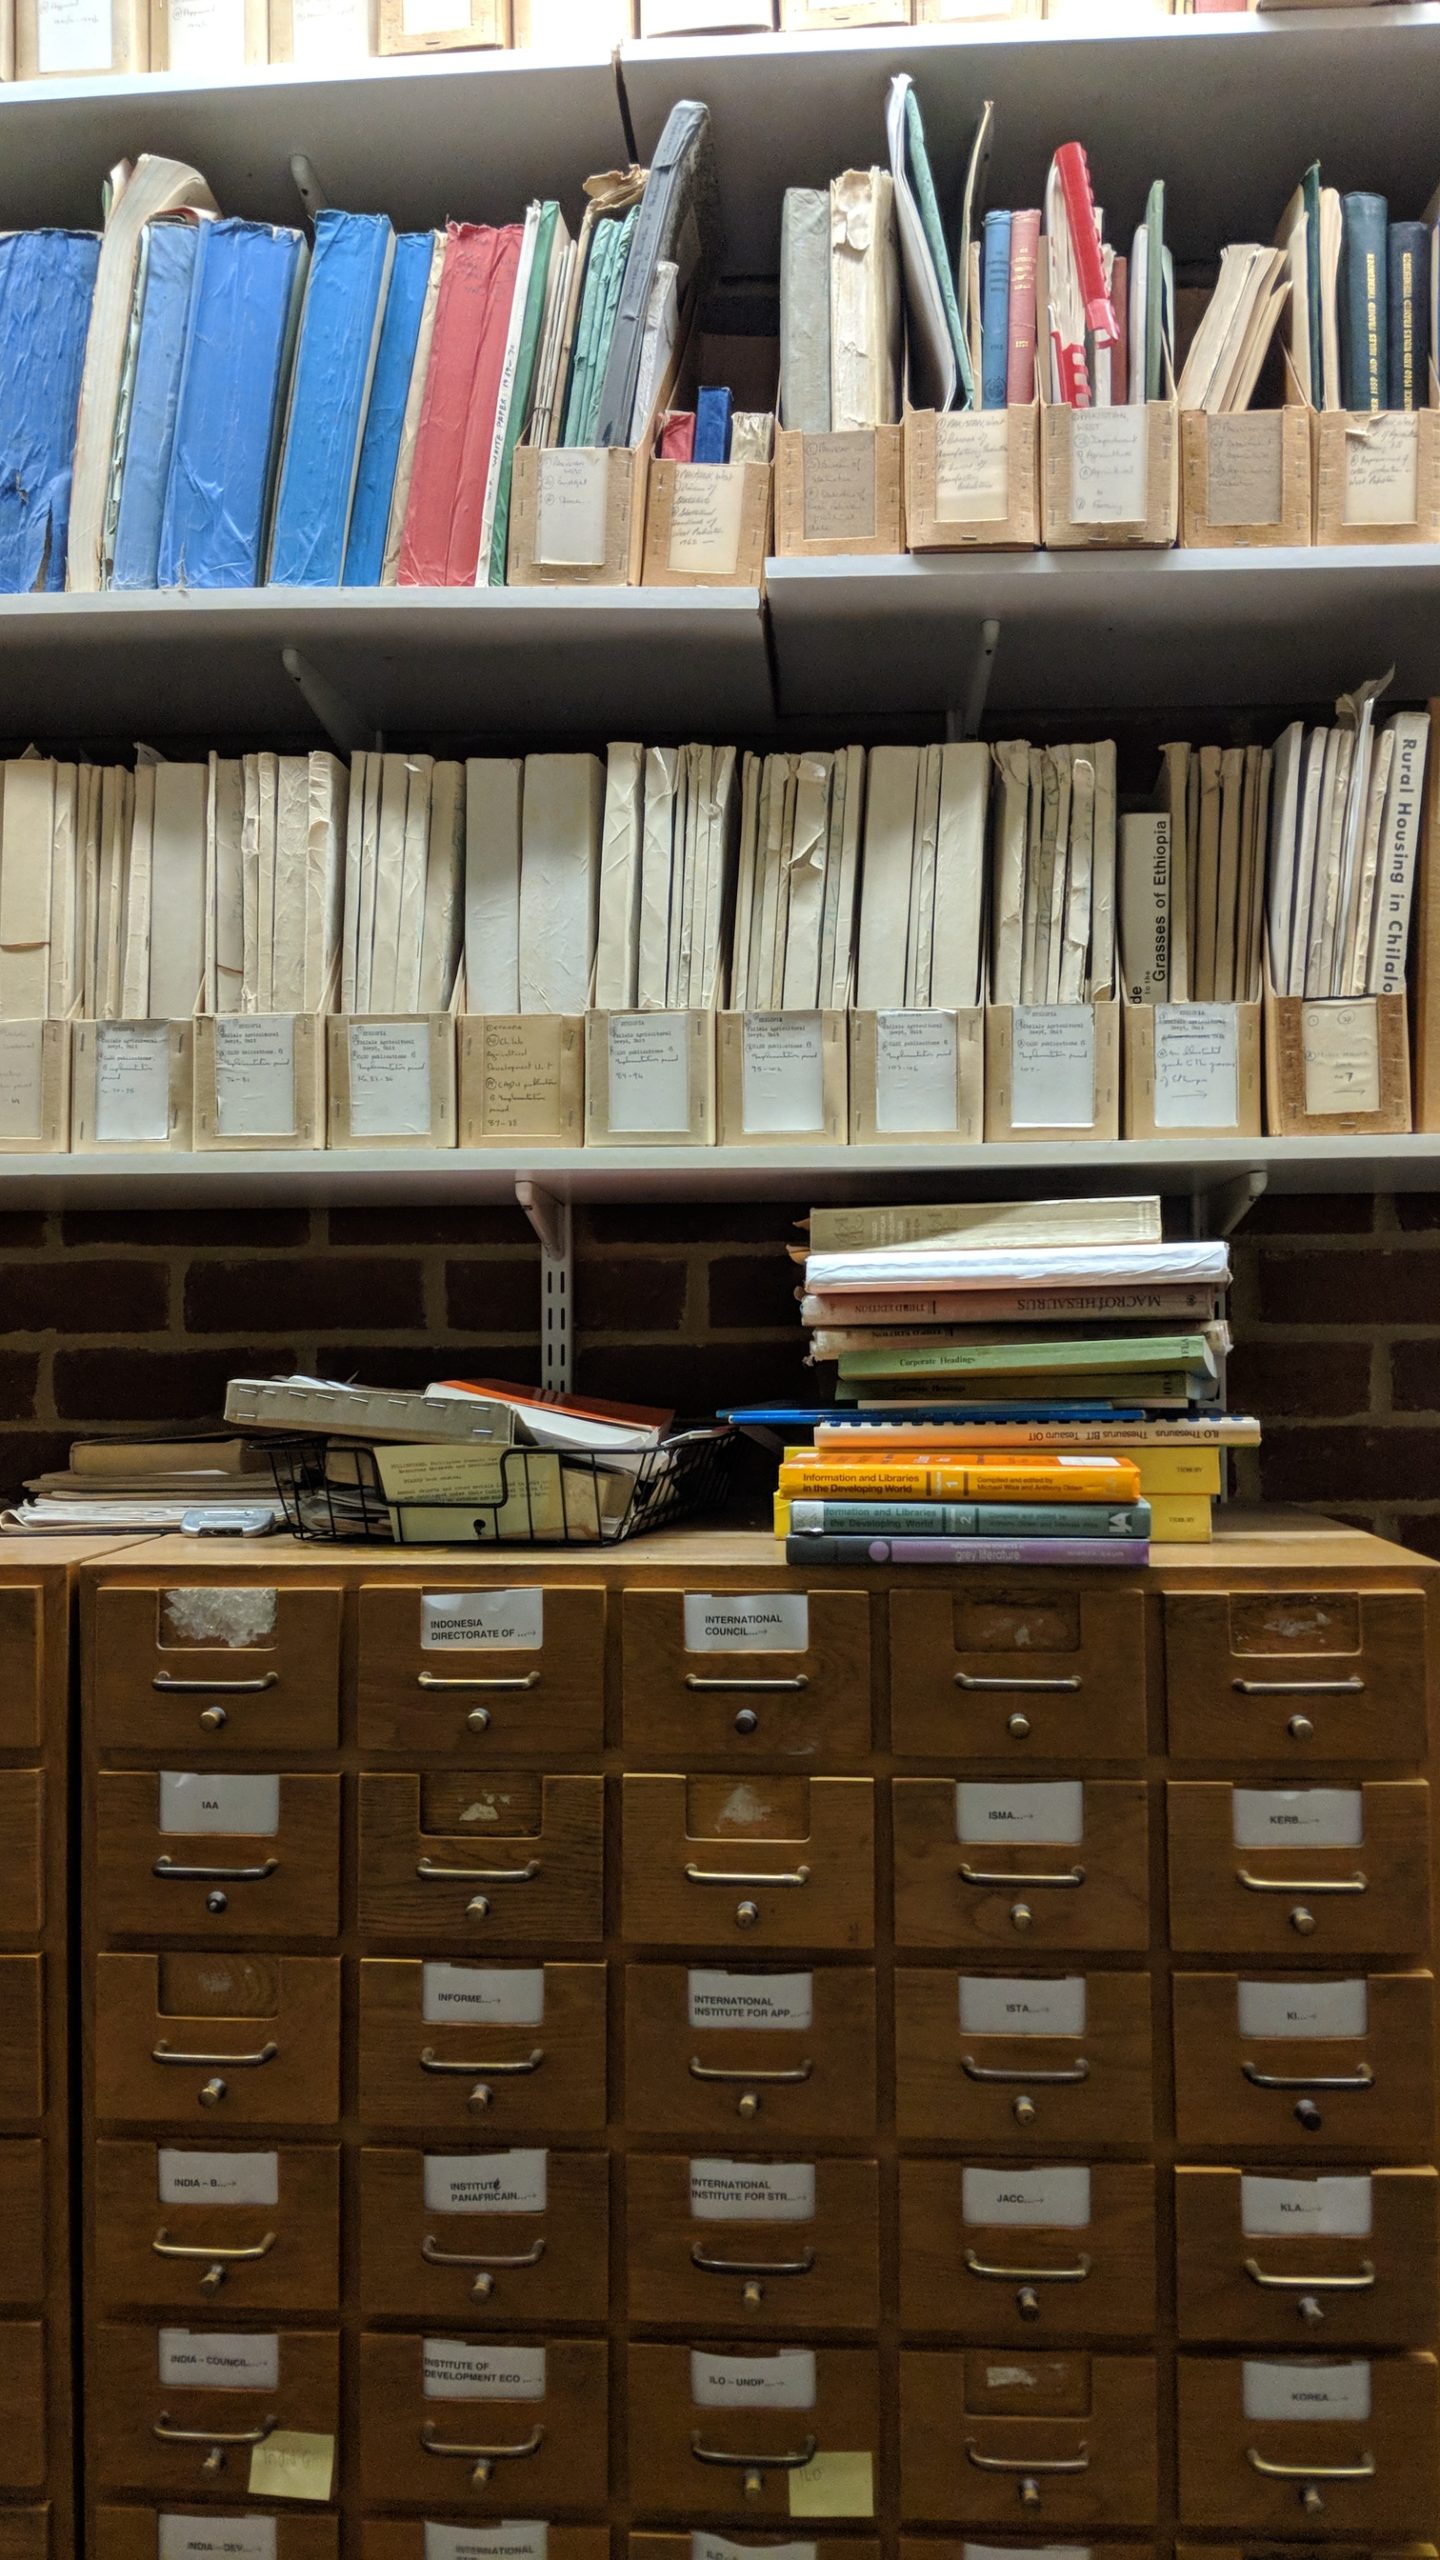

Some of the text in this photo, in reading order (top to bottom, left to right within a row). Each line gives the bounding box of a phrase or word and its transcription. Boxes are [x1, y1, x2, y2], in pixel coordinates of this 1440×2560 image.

[1383, 738, 1417, 993] Rural Housing in Chilalo
[1152, 820, 1168, 982] Grasses of Ethiopia
[1016, 1295, 1161, 1311] MACROTHESAURUS
[899, 1354, 976, 1368] Corporate Headings
[1028, 1432, 1080, 1442] Tesauro OIT
[1086, 1430, 1148, 1441] Thesaurus BIT
[1155, 1430, 1220, 1439] ILO Thesaurus
[803, 1474, 920, 1484] Information and Libraries
[803, 1485, 912, 1496] in the Developing World
[823, 1507, 937, 1518] formation and Libraries
[848, 1519, 901, 1531] Developing
[960, 1516, 972, 1525] 2
[955, 1548, 1021, 1563] grey literature
[430, 1618, 483, 1630] INDONESIA
[705, 1614, 783, 1625] INTERNATIONAL
[431, 1629, 515, 1641] DIRECTORATE OF
[201, 1801, 219, 1810] IAA
[694, 1996, 774, 2006] INTERNATIONAL
[694, 2008, 745, 2017] INSTITUTE
[747, 2008, 767, 2017] FOR
[174, 2178, 201, 2188] INDIA
[692, 2178, 771, 2189] INTERNATIONAL
[692, 2190, 742, 2200] INSTITUTE
[744, 2191, 765, 2201] FOR
[171, 2355, 198, 2364] INDIA
[424, 2358, 490, 2371] INSTITUTE OF
[424, 2369, 521, 2383] DEVELOPMENT ECO
[709, 2376, 726, 2385] ILO
[456, 2545, 534, 2554] INTERNATIONAL
